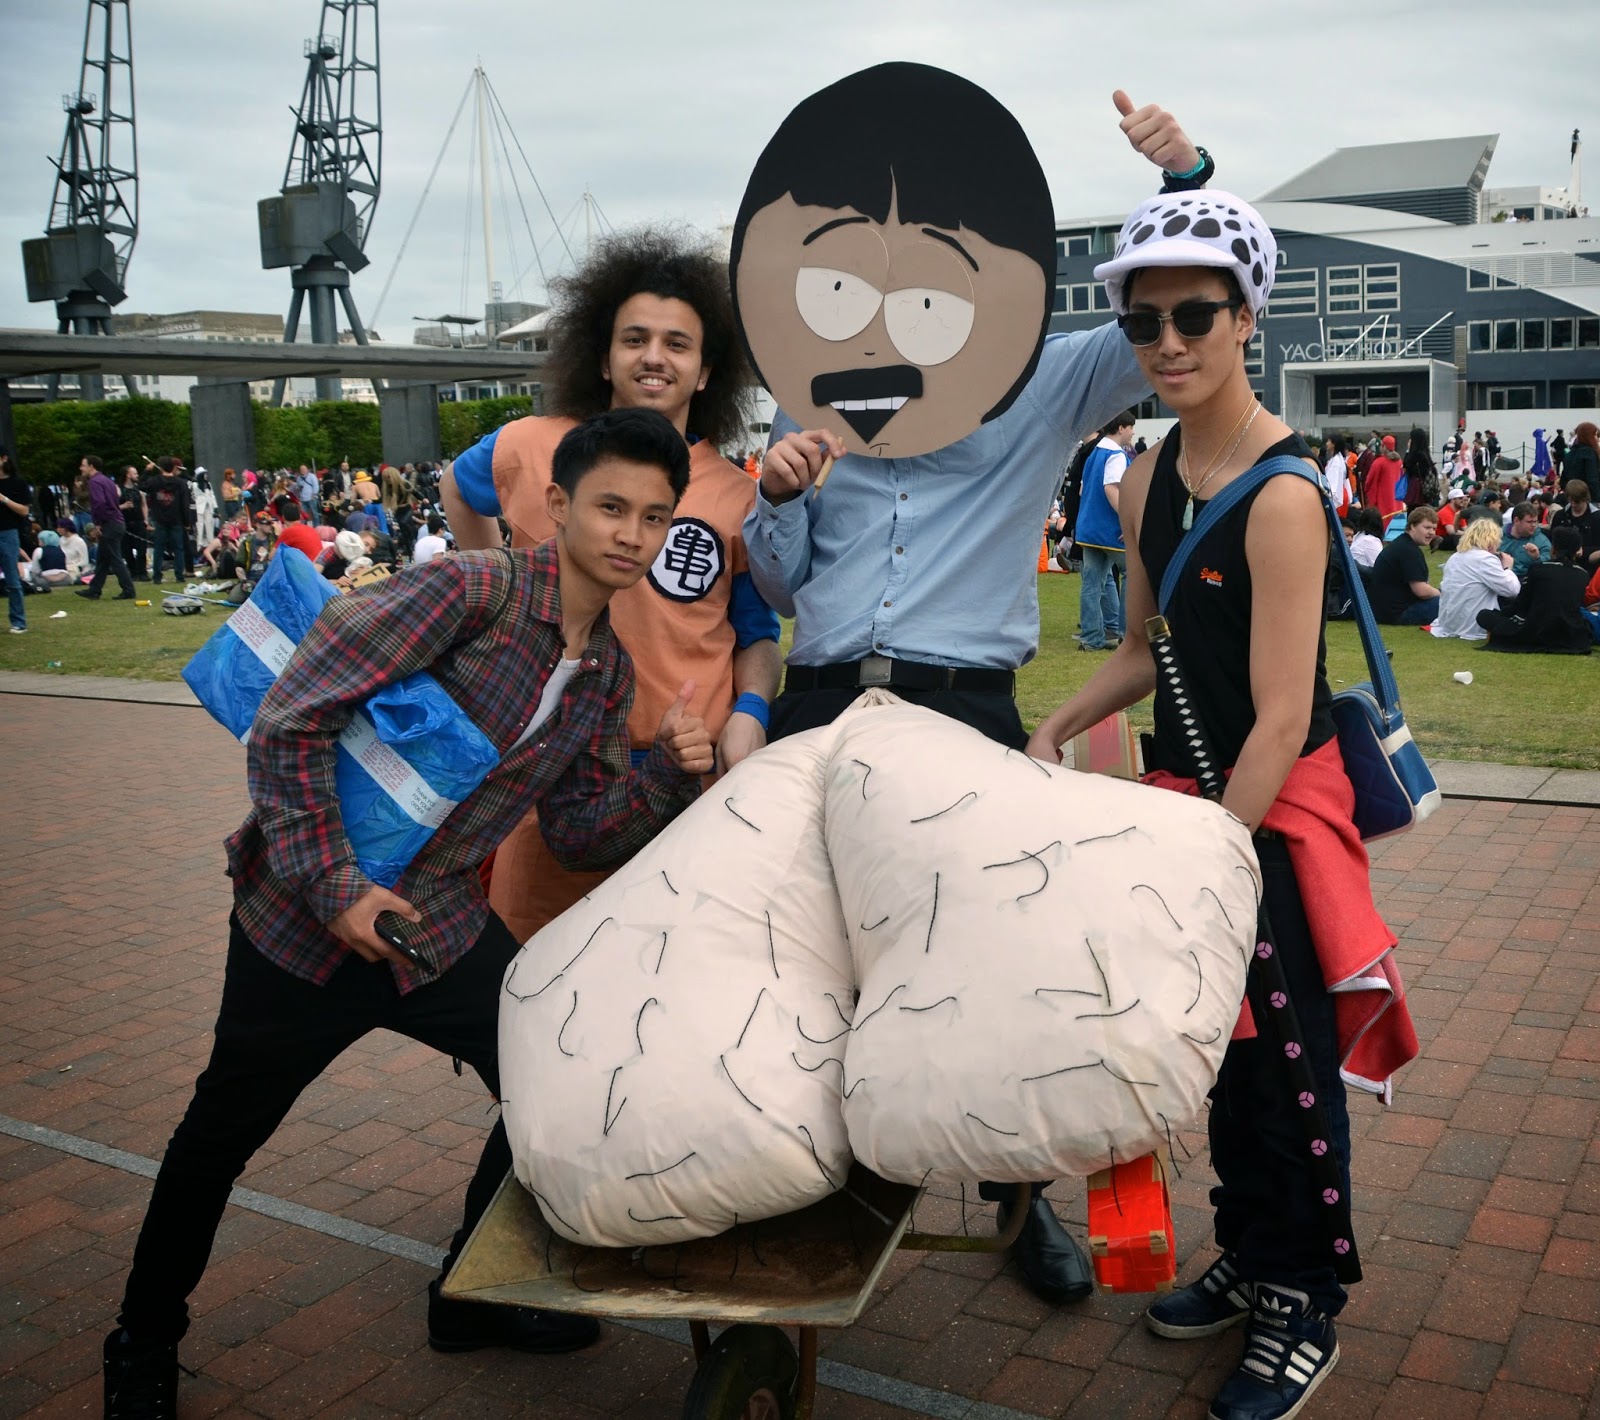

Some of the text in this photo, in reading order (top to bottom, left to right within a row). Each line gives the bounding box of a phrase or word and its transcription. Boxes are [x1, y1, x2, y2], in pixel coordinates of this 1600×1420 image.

[1279, 339, 1432, 361] YACHT HOTEL
[412, 793, 431, 811] FOR YOUR
[416, 787, 428, 801] THANK
[411, 800, 425, 815] ORDER
